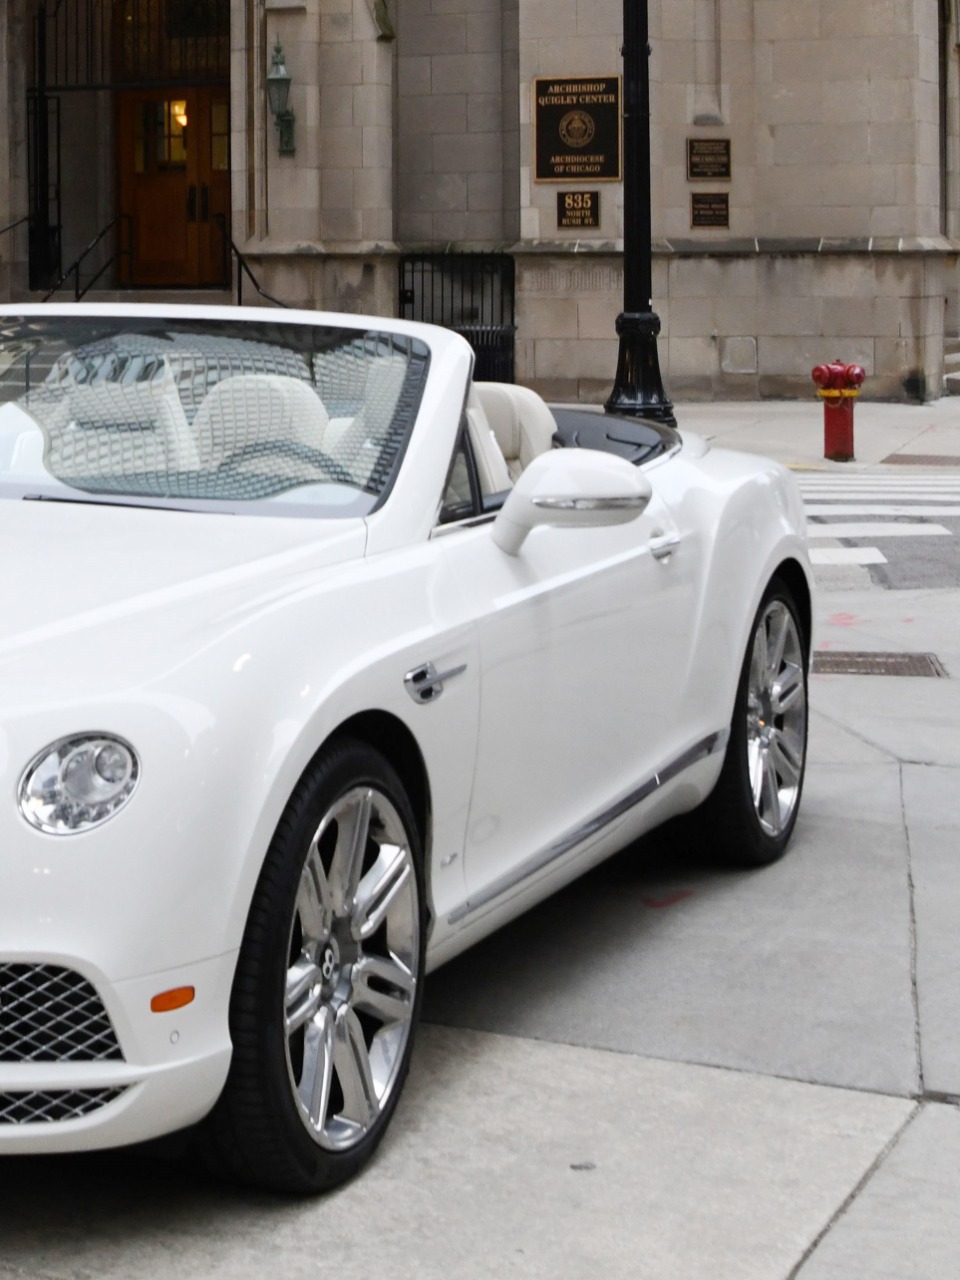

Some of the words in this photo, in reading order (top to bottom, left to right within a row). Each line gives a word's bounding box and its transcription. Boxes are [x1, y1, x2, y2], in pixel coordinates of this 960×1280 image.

[547, 83, 606, 94] ARCHBISHOP
[538, 96, 578, 107] QUIGLEY
[579, 94, 615, 105] CENTER
[550, 155, 605, 165] ARCHDIOCESE
[554, 165, 565, 174] OF
[566, 165, 601, 173] CHICAGO
[564, 193, 592, 209] 835
[565, 209, 591, 217] NORTH
